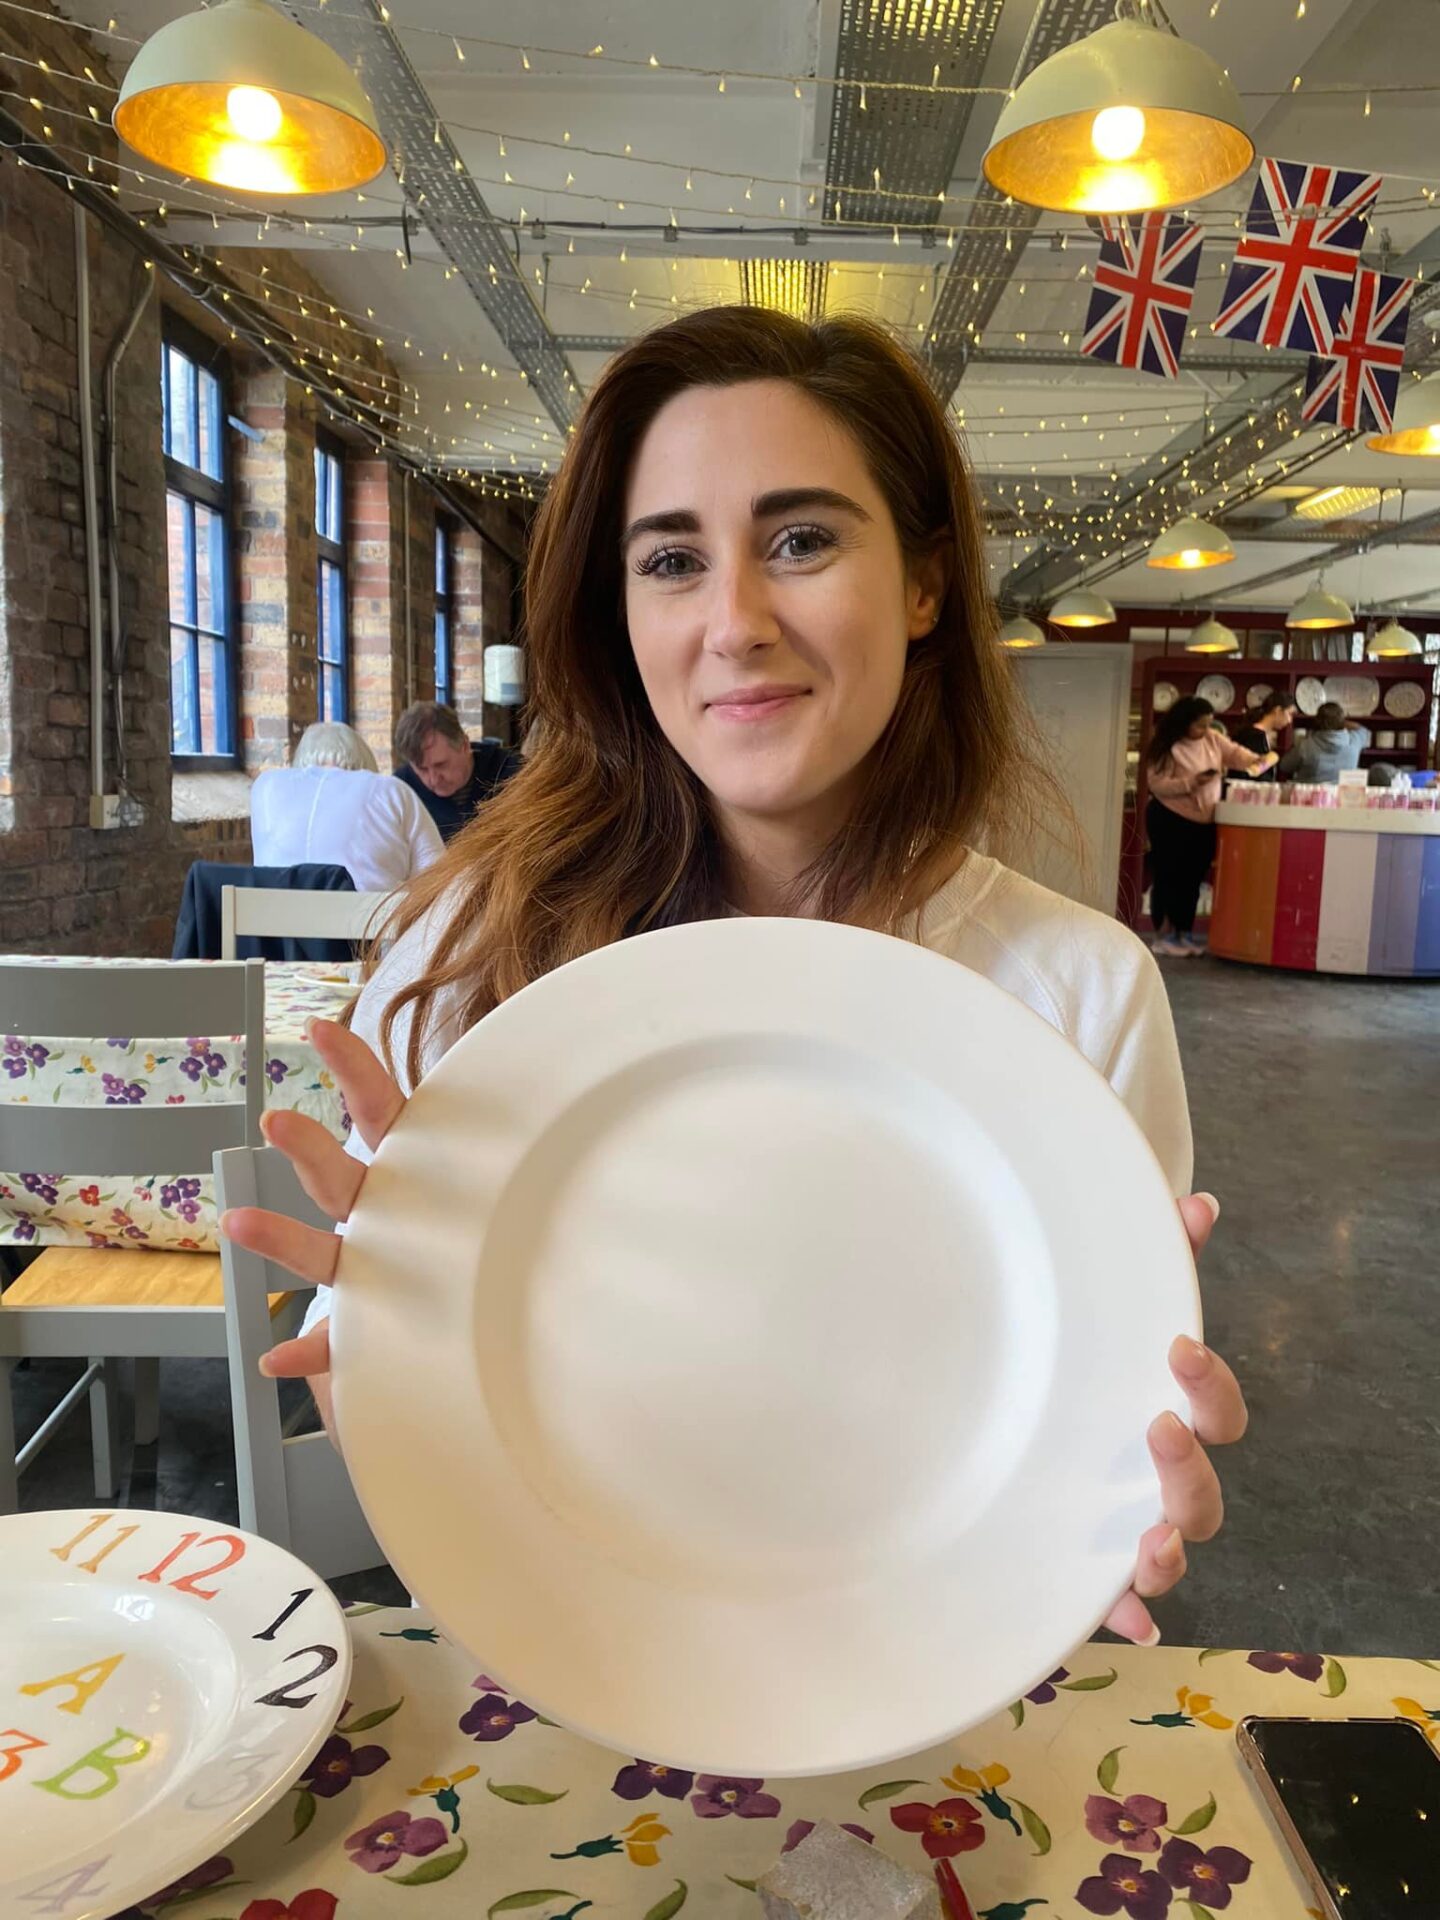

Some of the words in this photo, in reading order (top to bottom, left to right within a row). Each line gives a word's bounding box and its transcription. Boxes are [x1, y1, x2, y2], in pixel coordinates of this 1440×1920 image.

[49, 1513, 142, 1574] 11
[137, 1531, 247, 1601] 12
[252, 1588, 315, 1641] 1
[18, 1653, 126, 1716] A
[254, 1644, 339, 1710] 2
[30, 1726, 151, 1801] B
[183, 1750, 282, 1812] 3
[14, 1853, 113, 1915] 4
